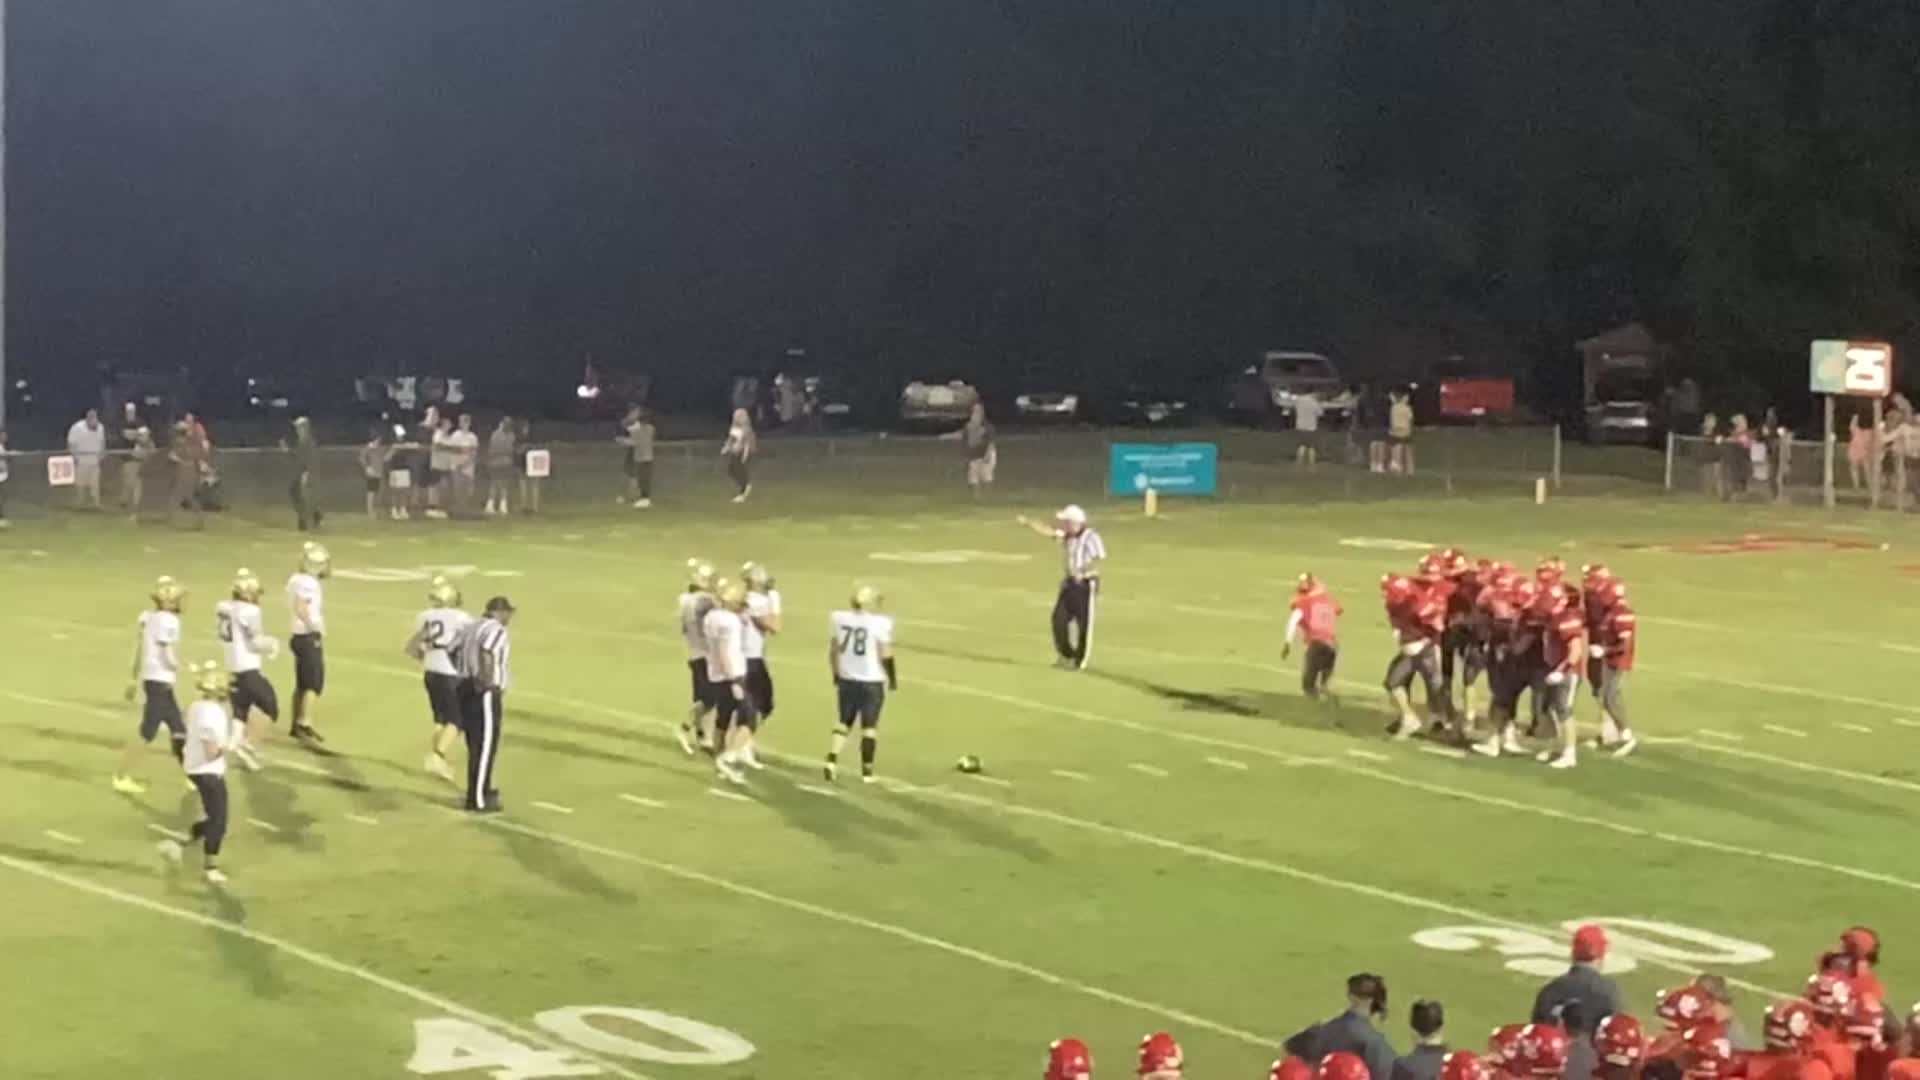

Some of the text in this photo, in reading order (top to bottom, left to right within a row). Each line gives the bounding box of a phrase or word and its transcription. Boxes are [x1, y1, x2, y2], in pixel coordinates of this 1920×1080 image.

[840, 625, 868, 656] 78
[1410, 916, 1774, 977] 30
[404, 1004, 757, 1079] 40
